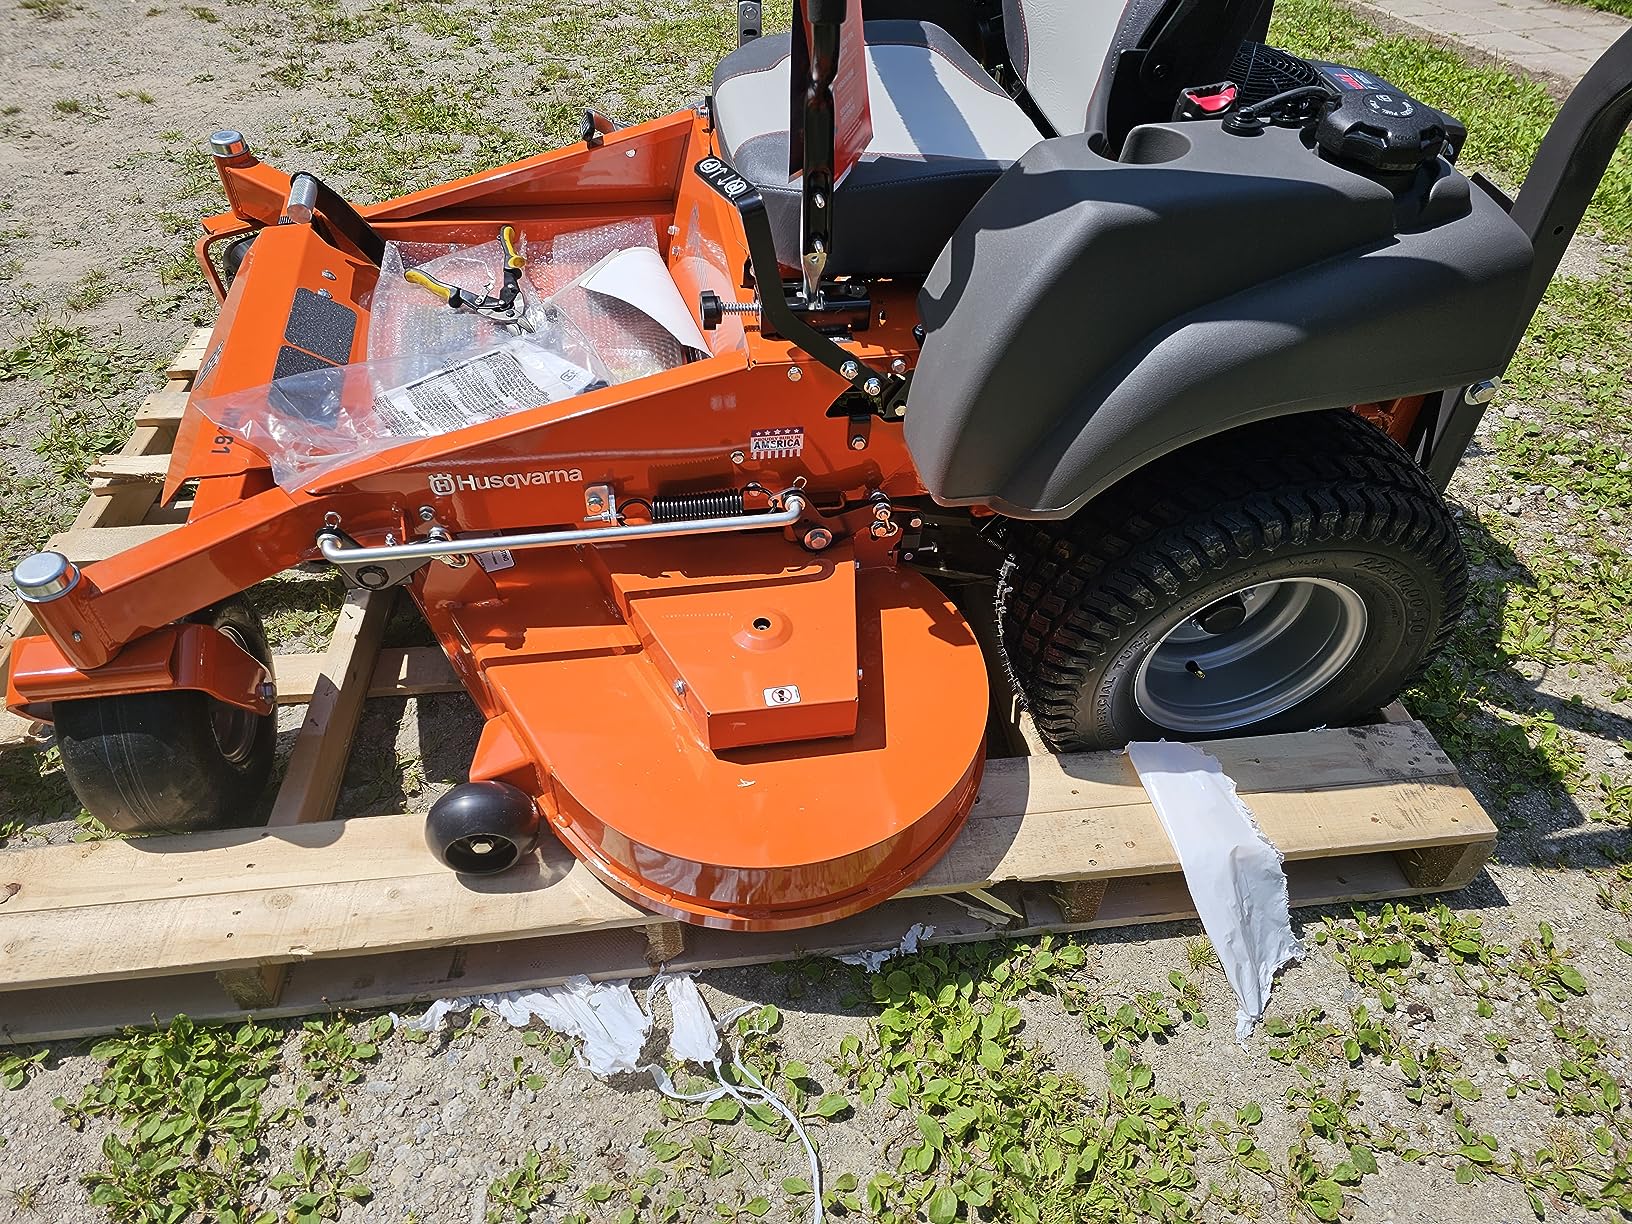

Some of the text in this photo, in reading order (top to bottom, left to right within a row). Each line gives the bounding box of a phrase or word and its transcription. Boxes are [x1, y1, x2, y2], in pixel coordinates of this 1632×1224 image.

[753, 438, 801, 450] AMERICA
[457, 467, 583, 491] Husqvarna
[1112, 630, 1151, 670] TURF
